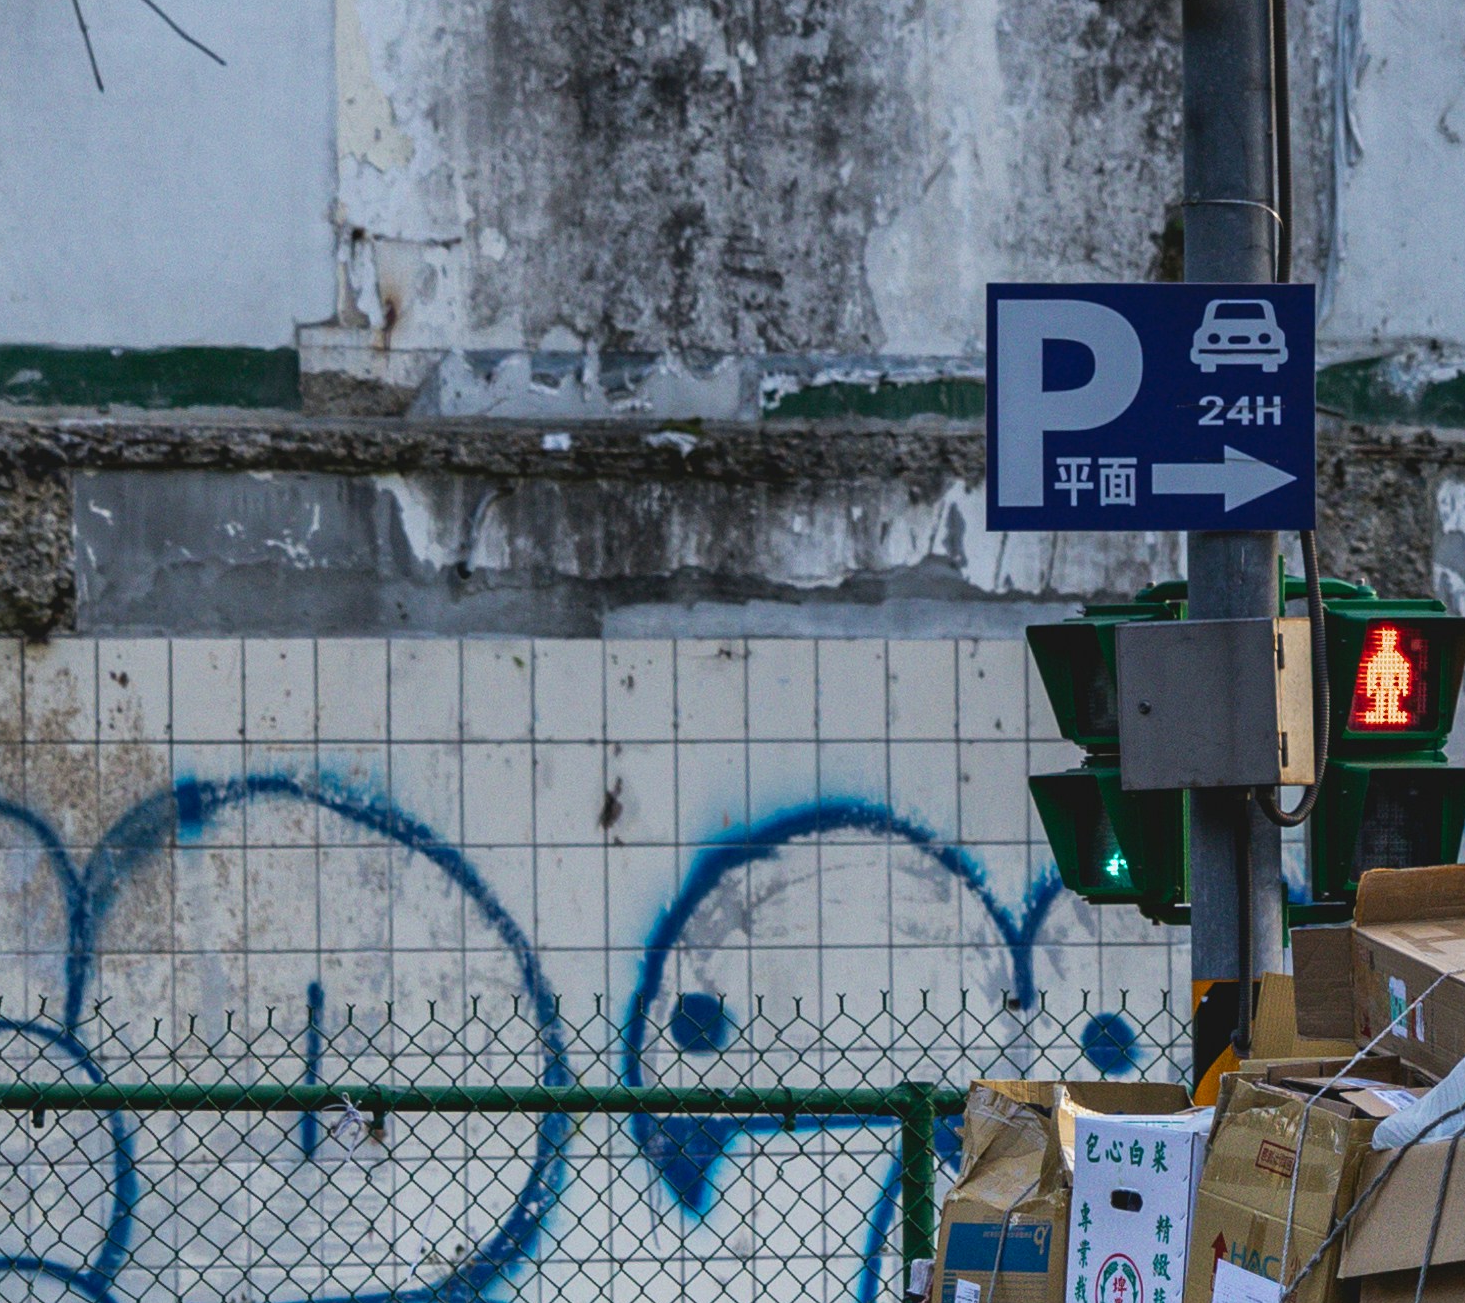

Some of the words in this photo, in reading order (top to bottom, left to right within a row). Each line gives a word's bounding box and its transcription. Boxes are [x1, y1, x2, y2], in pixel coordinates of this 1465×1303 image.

[996, 298, 1144, 508] P
[1197, 395, 1282, 426] 24H
[1053, 456, 1138, 507] 平面
[1085, 1132, 1169, 1174] 包心白菜
